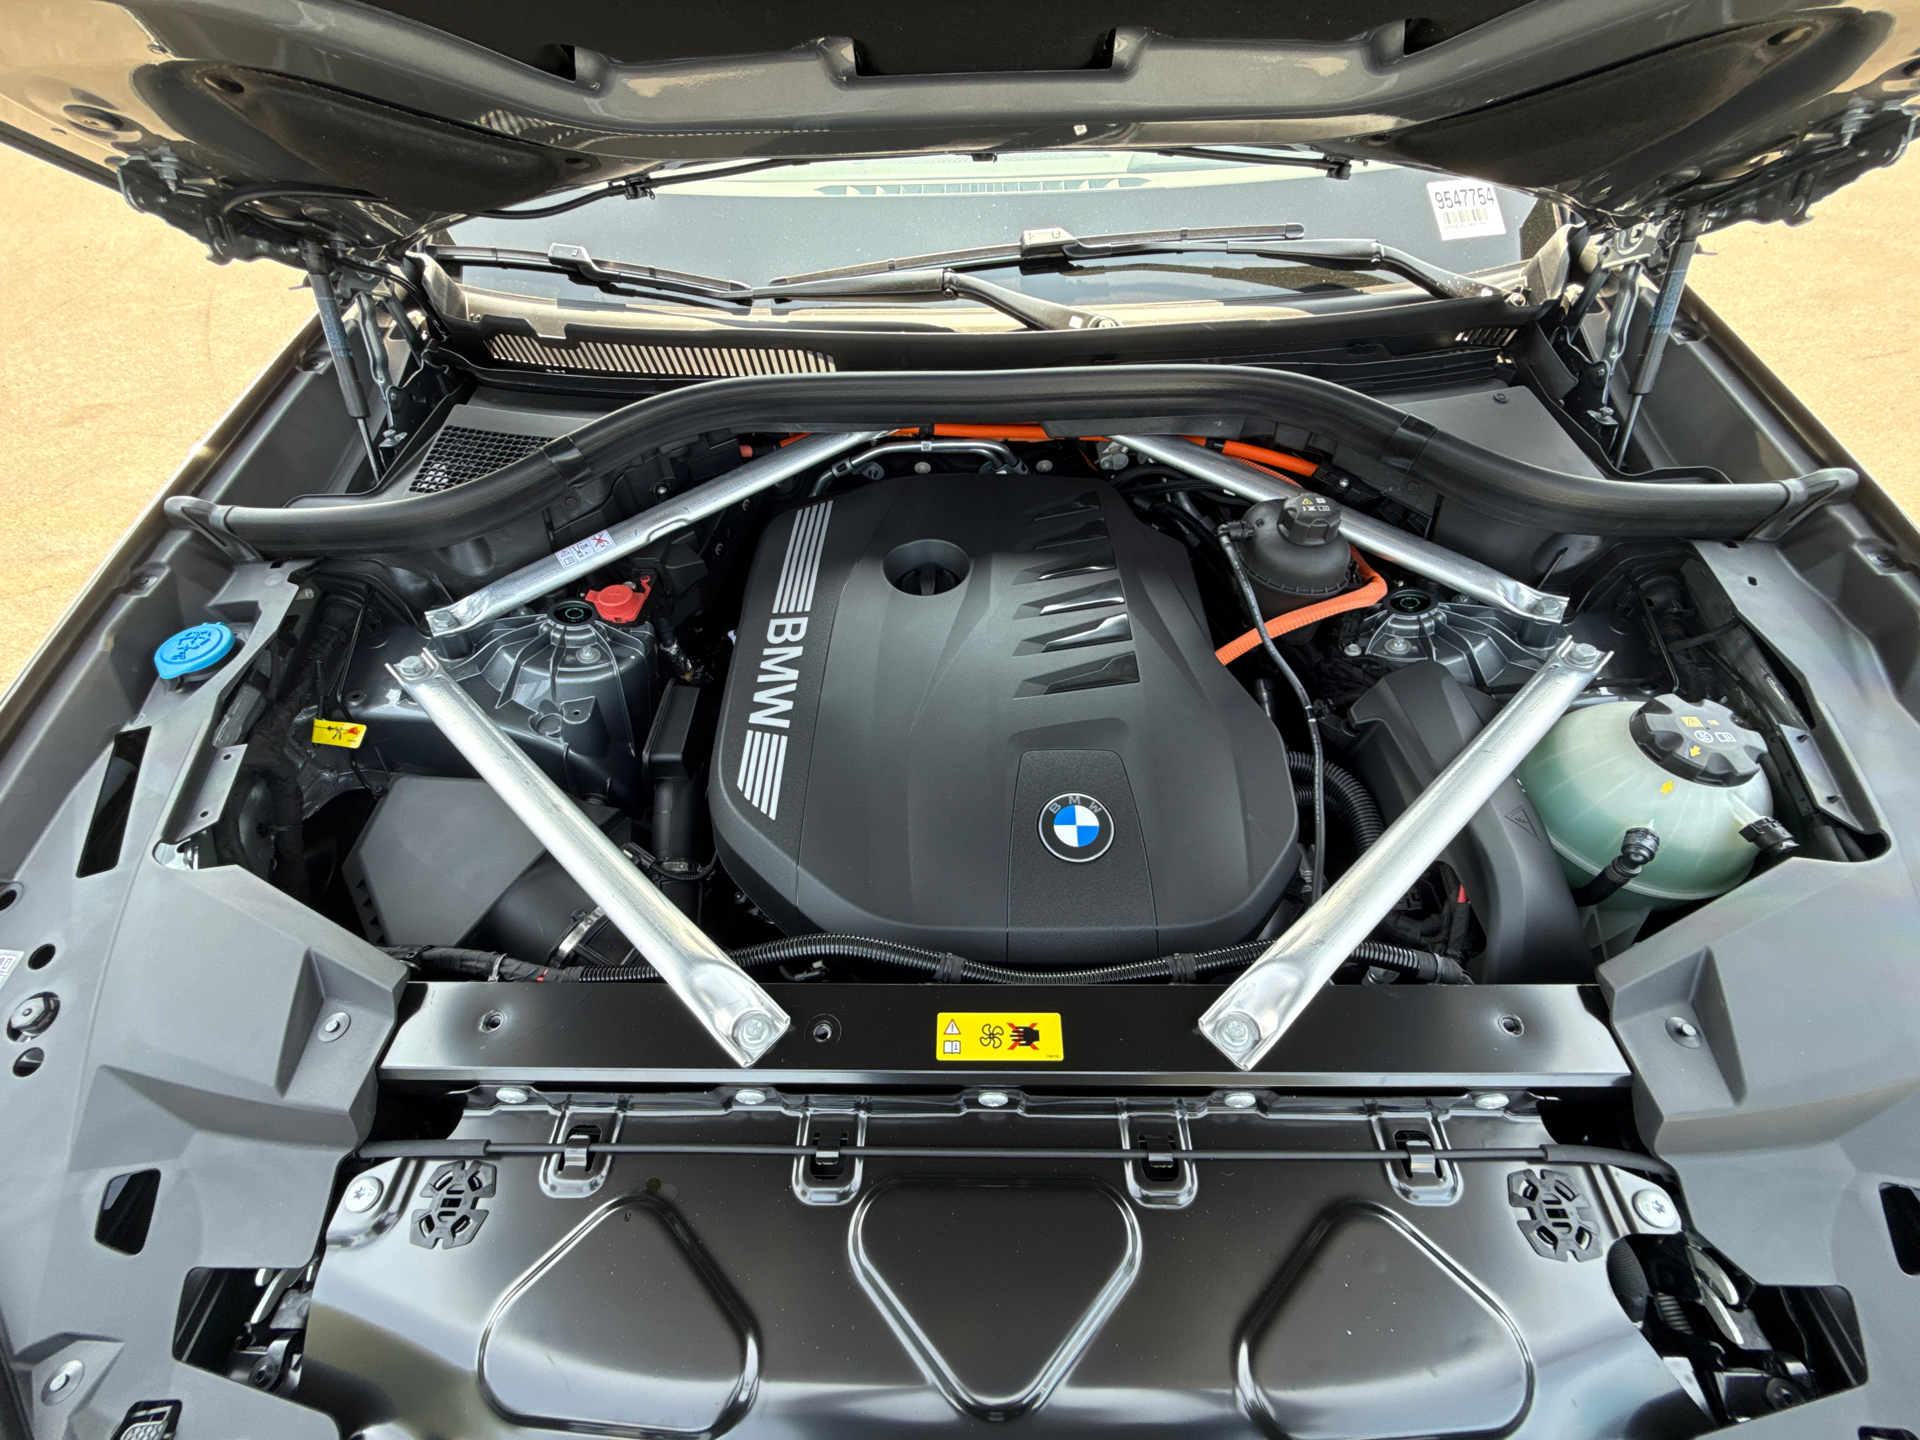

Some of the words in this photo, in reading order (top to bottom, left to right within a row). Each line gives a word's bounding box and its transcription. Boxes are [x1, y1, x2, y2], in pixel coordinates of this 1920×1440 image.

[1434, 187, 1494, 209] 9547754
[748, 616, 809, 729] BMW
[1048, 795, 1102, 815] BMW
